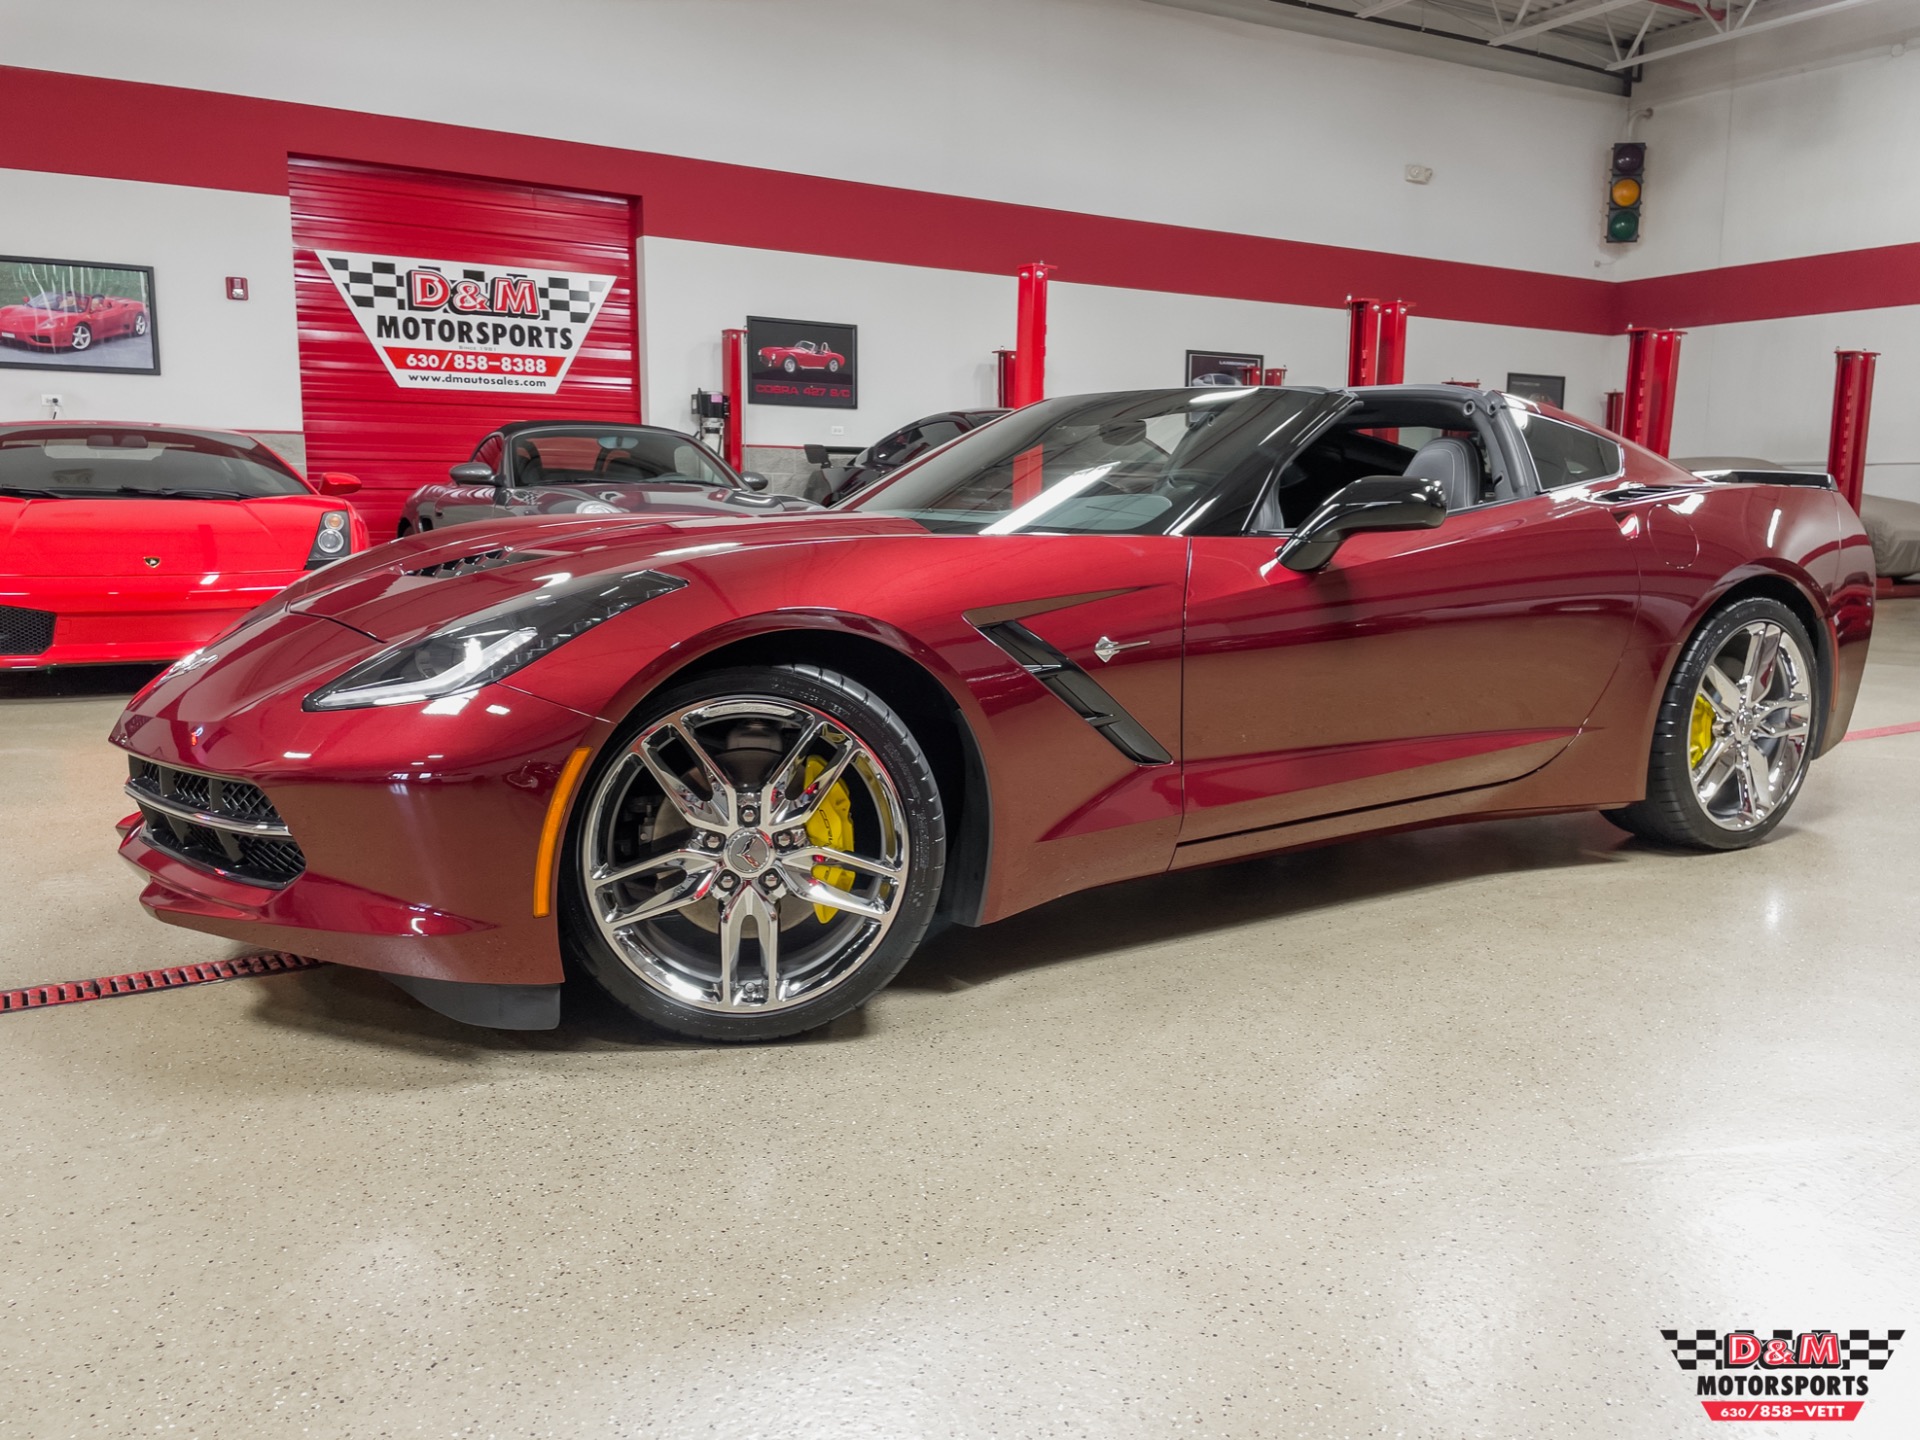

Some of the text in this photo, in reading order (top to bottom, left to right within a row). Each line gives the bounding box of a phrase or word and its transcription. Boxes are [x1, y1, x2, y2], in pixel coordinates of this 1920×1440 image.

[407, 269, 541, 318] D&M
[376, 315, 573, 350] MOTORSPORTS
[406, 352, 547, 374] 630/858-8388
[408, 374, 547, 388] www.dmautosales.com
[755, 384, 799, 396] COBRA
[803, 387, 827, 397] 427
